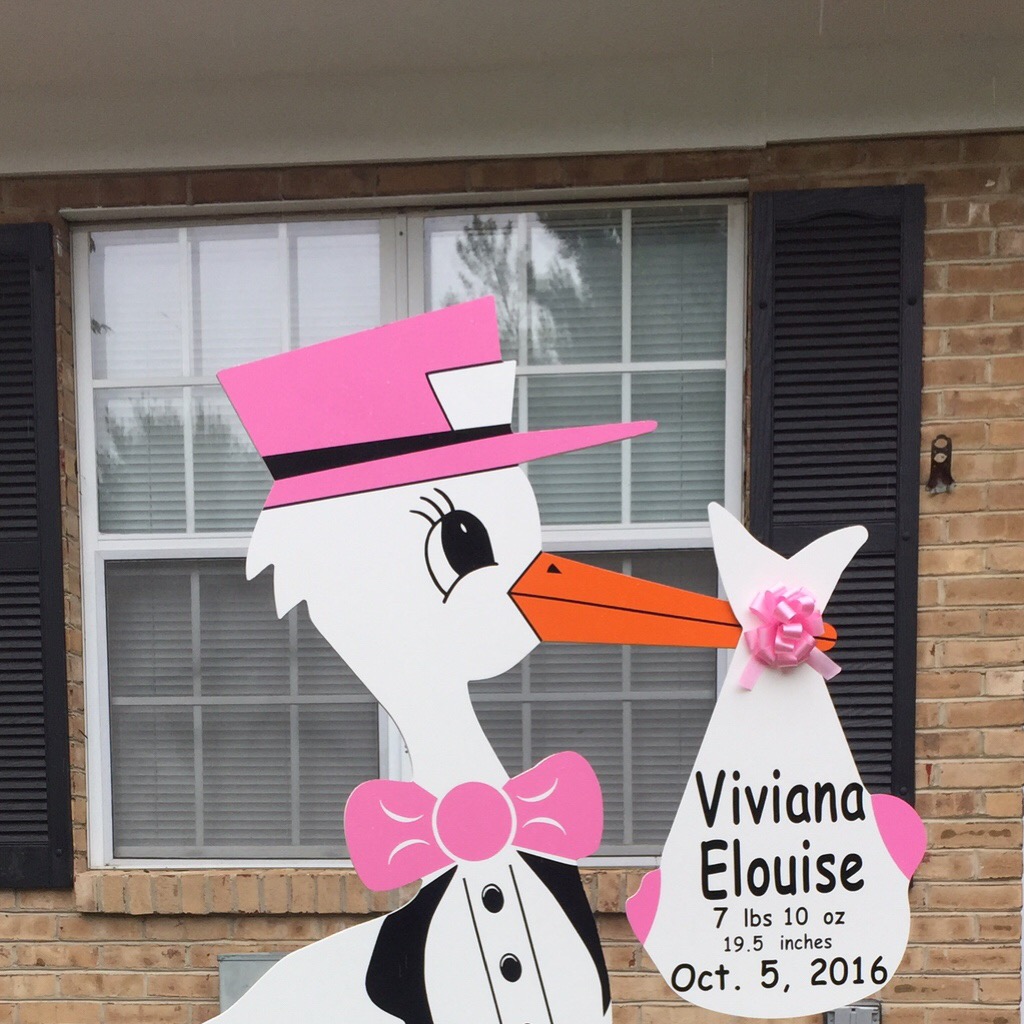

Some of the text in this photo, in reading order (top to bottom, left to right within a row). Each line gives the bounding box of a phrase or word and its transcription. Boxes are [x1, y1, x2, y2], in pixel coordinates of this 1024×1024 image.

[695, 768, 866, 828] Viviana
[700, 838, 865, 901] Elouise
[713, 906, 845, 929] 7 lbs 10 oz
[724, 933, 832, 953] 19.5 inches
[671, 955, 888, 993] Oct. 5, 2016
